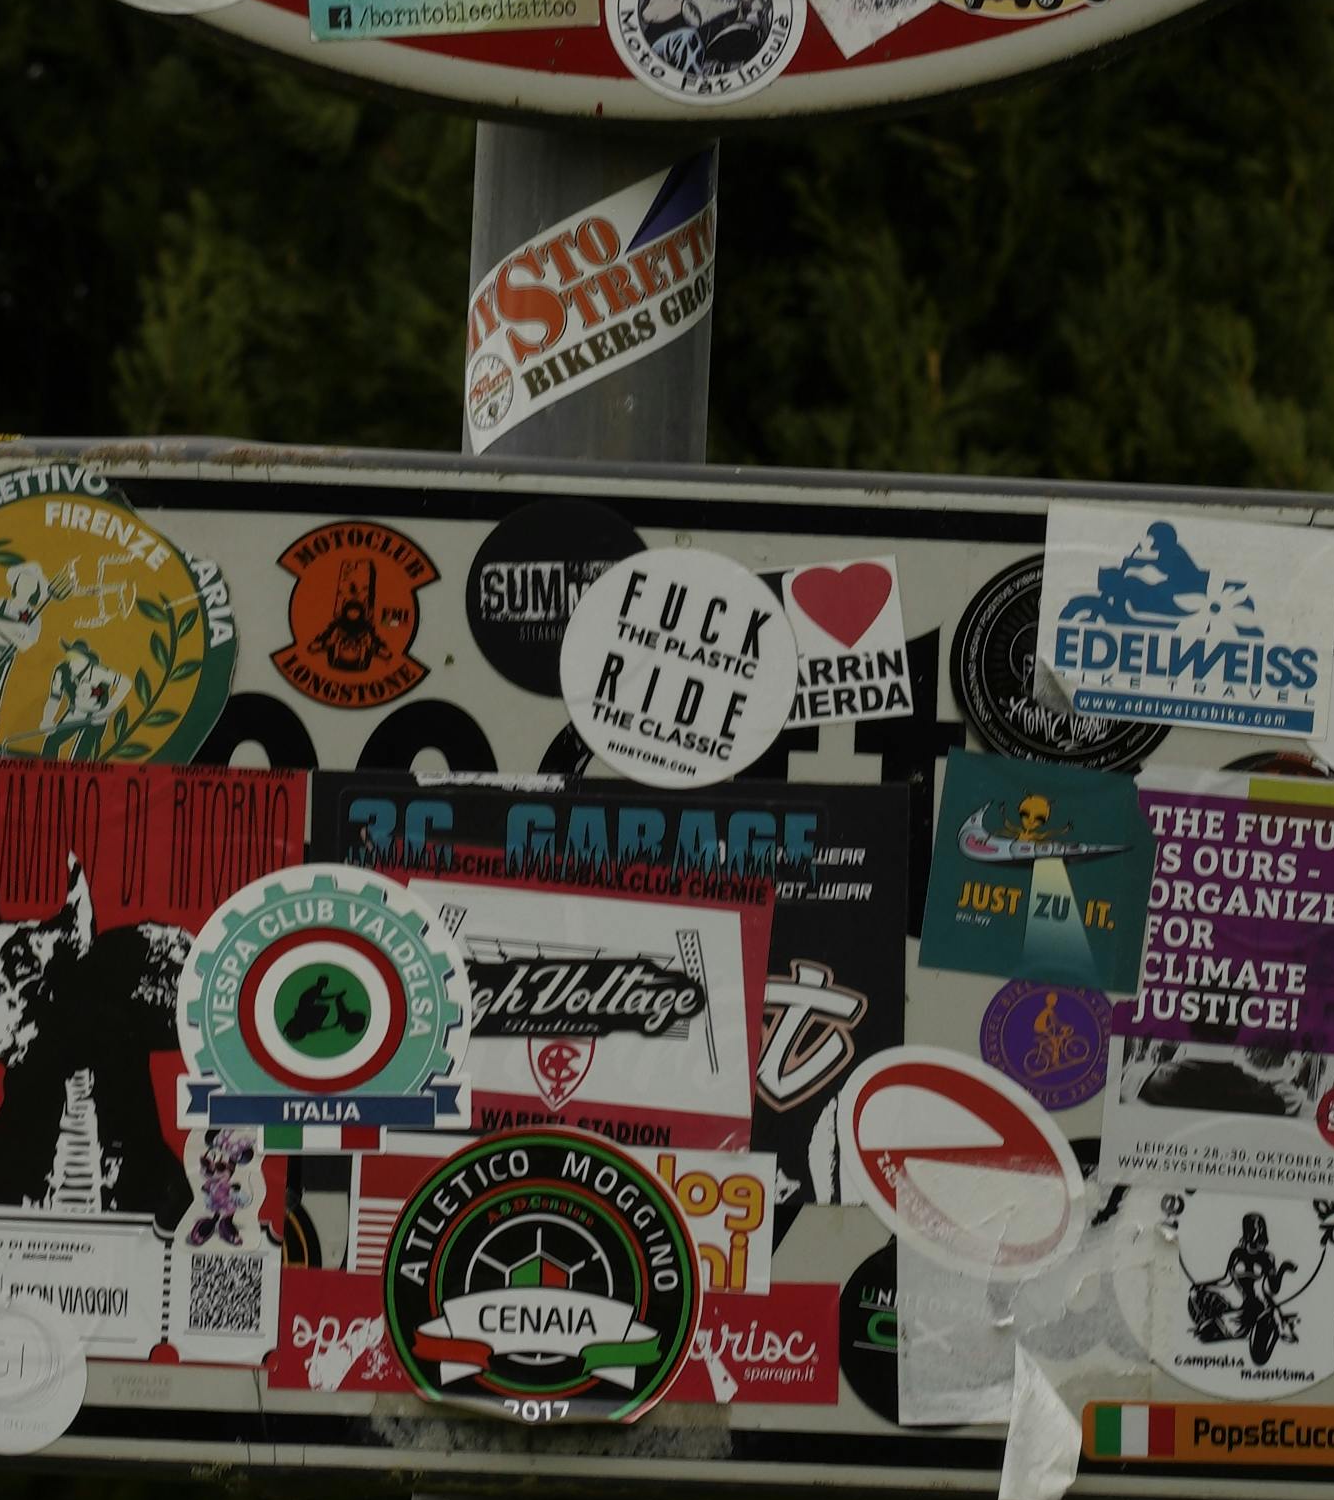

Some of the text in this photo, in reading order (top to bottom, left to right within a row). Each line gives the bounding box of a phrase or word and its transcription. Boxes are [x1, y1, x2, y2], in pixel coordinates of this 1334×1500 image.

[620, 9, 666, 79] Moto
[521, 307, 657, 400] BIKERS
[44, 501, 173, 572] FIRENZE
[292, 527, 426, 580] MOTOCLUB
[619, 569, 771, 659] FUCK
[617, 622, 758, 681] THE PLASTIC
[1054, 627, 1319, 690] EDELWEISS
[281, 663, 416, 703] LONGSTONE
[594, 652, 747, 742] RIDE
[1178, 680, 1317, 708] TRAVEL
[591, 703, 732, 761] THE CLASSIC
[1078, 694, 1288, 728] www.edelweissbike.com
[121, 778, 290, 910] DI RITORNO
[503, 803, 820, 888] GARAGE
[1149, 804, 1226, 842] THE
[1192, 846, 1298, 884] OURS
[957, 881, 1116, 931] JUST ZU IT.
[1149, 917, 1215, 951] FOR
[210, 899, 435, 1039] VESPA CLUB VALDELSA
[1143, 950, 1308, 997] CLIMATE
[528, 962, 699, 1031] Voltage
[1131, 987, 1301, 1032] JUSTICE!
[281, 1099, 362, 1123] ITALIA
[1135, 1141, 1190, 1159] LEIPZIG
[1254, 1151, 1323, 1168] OKTOBER
[397, 1148, 531, 1287] ATLETICO
[560, 1149, 681, 1295] MOGGINO
[477, 1303, 598, 1336] CENAIA
[741, 1365, 817, 1384] sparagn.it
[503, 1399, 572, 1424] 2017
